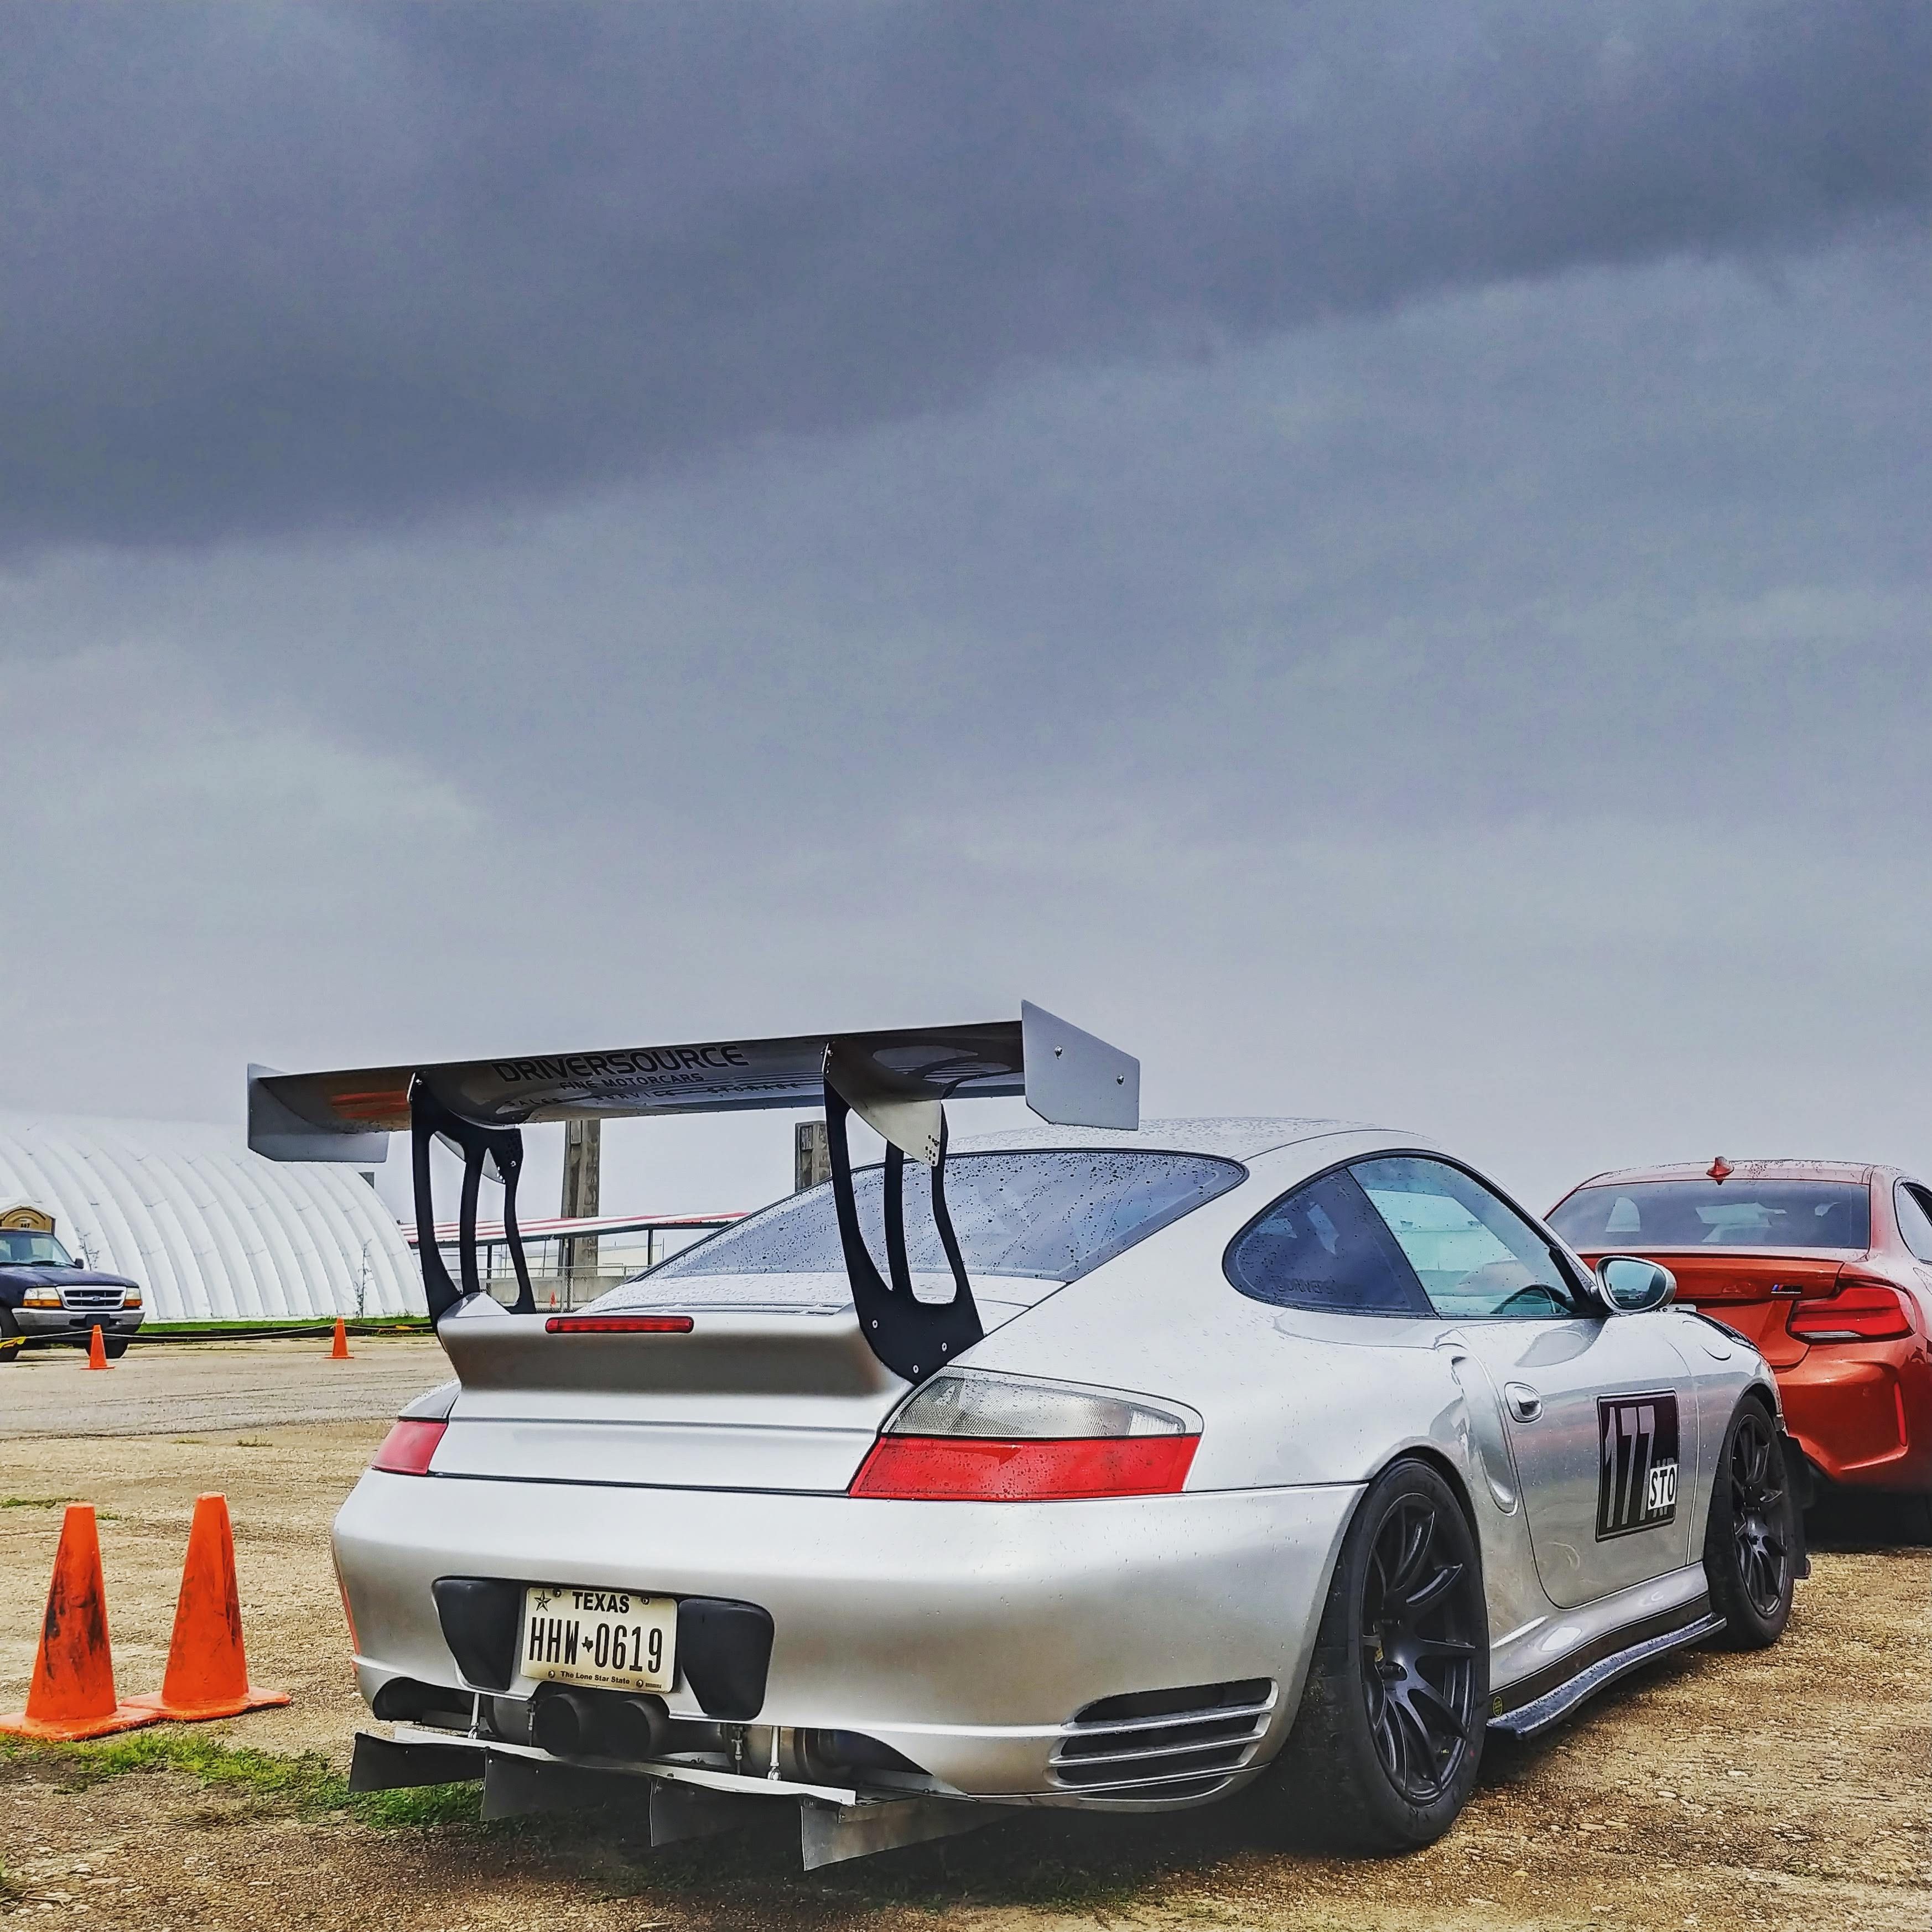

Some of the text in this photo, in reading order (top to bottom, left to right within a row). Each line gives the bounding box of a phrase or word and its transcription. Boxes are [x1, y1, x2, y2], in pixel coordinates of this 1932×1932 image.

[491, 1045, 750, 1082] DRIVERSOURCE
[505, 1082, 801, 1107] SALES SERVICE STORAGE
[559, 1073, 704, 1090] FINE MOTORCARS
[1605, 1405, 1655, 1528] 177
[1650, 1467, 1675, 1507] STO
[572, 1591, 630, 1614] TEXAS
[529, 1617, 663, 1673] HHW 0619
[560, 1670, 574, 1679] The
[611, 1676, 630, 1685] State
